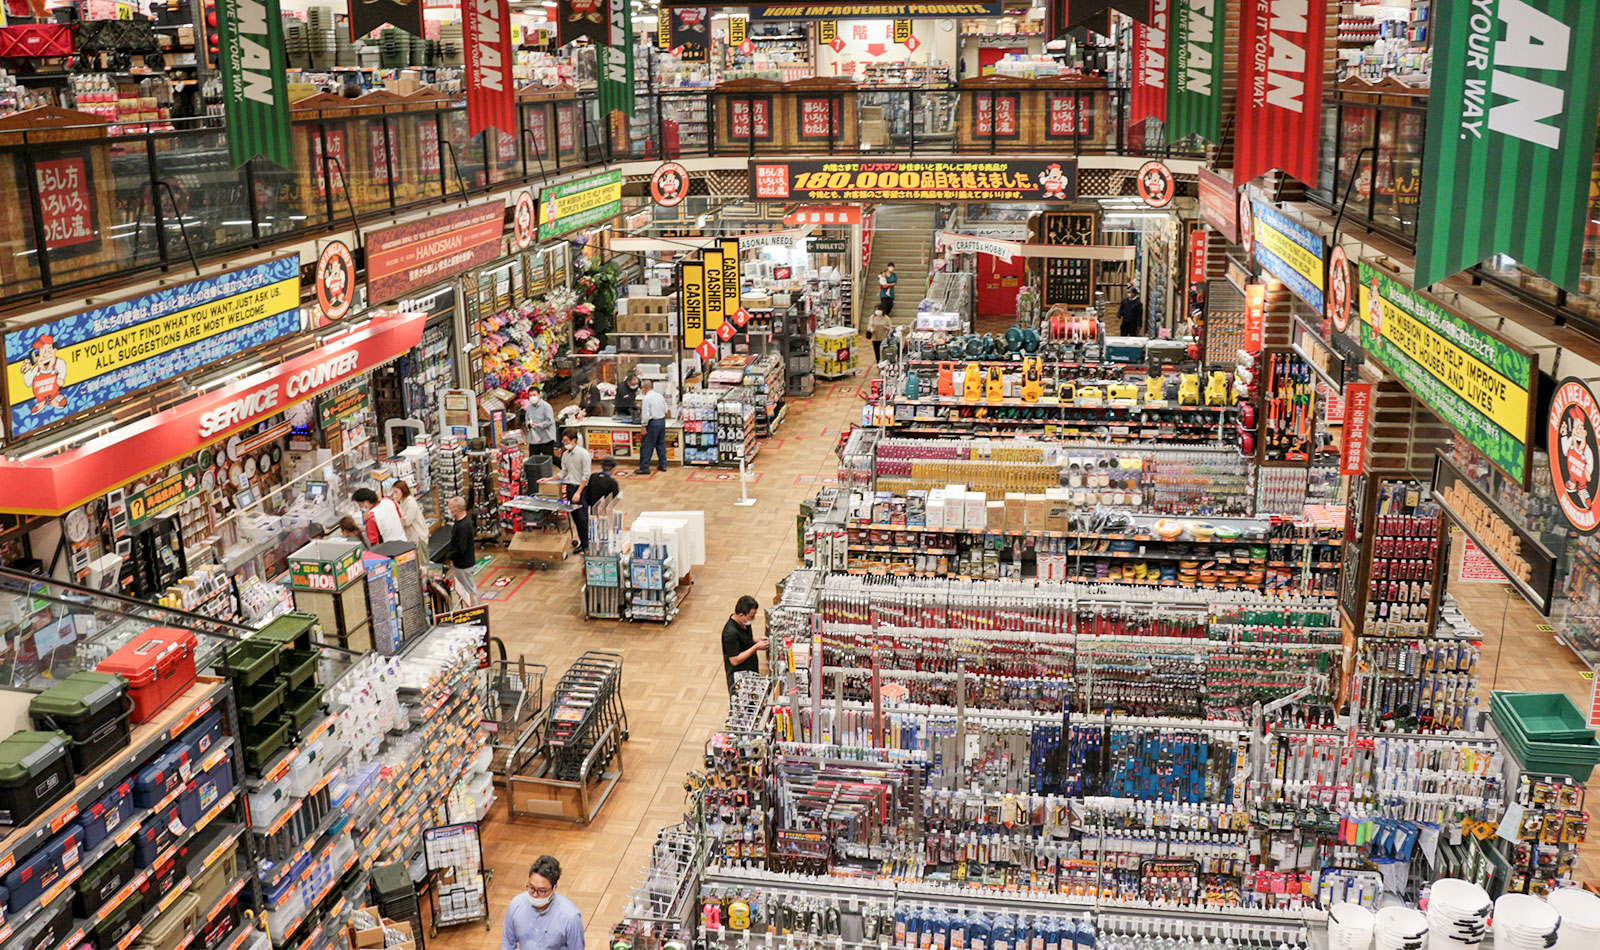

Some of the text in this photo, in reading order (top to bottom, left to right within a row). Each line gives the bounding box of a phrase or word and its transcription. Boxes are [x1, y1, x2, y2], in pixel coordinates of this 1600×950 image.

[763, 4, 991, 17] HOME IMPROVEMENT PRODUCTS.
[228, 22, 237, 34] IT
[732, 16, 744, 42] SHIER
[823, 20, 834, 40] HIER
[897, 19, 908, 39] HIER
[1256, 16, 1268, 31] IT
[469, 13, 481, 90] LIVE IT YOUR WAY.
[743, 42, 750, 52] 6
[834, 39, 841, 50] 7
[908, 37, 915, 48] 8
[979, 36, 1026, 44] エレベーター
[1176, 9, 1188, 94] LIVE IT YOUR WAY.
[229, 38, 241, 70] YOUR
[1139, 49, 1147, 69] YOUR
[1254, 33, 1267, 72] YOUR
[1266, 0, 1309, 113] MAN
[1138, 70, 1146, 87] WAY.
[1460, 0, 1494, 140] YOUR WAY.
[232, 74, 243, 103] WAY.
[1252, 76, 1266, 109] WAY.
[734, 103, 763, 114] 暮ら方
[734, 124, 767, 135] わた流。
[757, 167, 785, 177] 暮らし方
[416, 234, 462, 260] HANDSMAN
[739, 236, 793, 249] EASONAL NEEDS
[956, 241, 980, 250] CRAFTS
[984, 244, 1007, 256] HOBBY
[723, 258, 736, 298] CASHIER
[707, 269, 721, 312] CASHIER
[686, 284, 700, 329] CASHIER
[737, 311, 744, 324] 3
[71, 350, 82, 363] IF
[85, 341, 104, 359] YOU
[107, 331, 137, 351] CAN'T
[139, 325, 161, 342] FIND
[163, 317, 188, 335] WHAT
[192, 311, 208, 326] YOU
[254, 291, 269, 304] ASK
[270, 287, 281, 299] US.
[722, 325, 730, 338] 2
[95, 304, 267, 371] ALL SUGGESTIONS ARE MOST WELCOME.
[702, 344, 708, 357] 1
[1383, 304, 1507, 402] OUR MISSION IS TO HELP IMPROVE
[1389, 324, 1495, 414] PEOPLE'S HOUSES AND LIVES.
[198, 383, 280, 438] SERVICE
[285, 349, 360, 399] COUNTER
[1551, 394, 1563, 431] MAY
[1567, 384, 1592, 409] HELP
